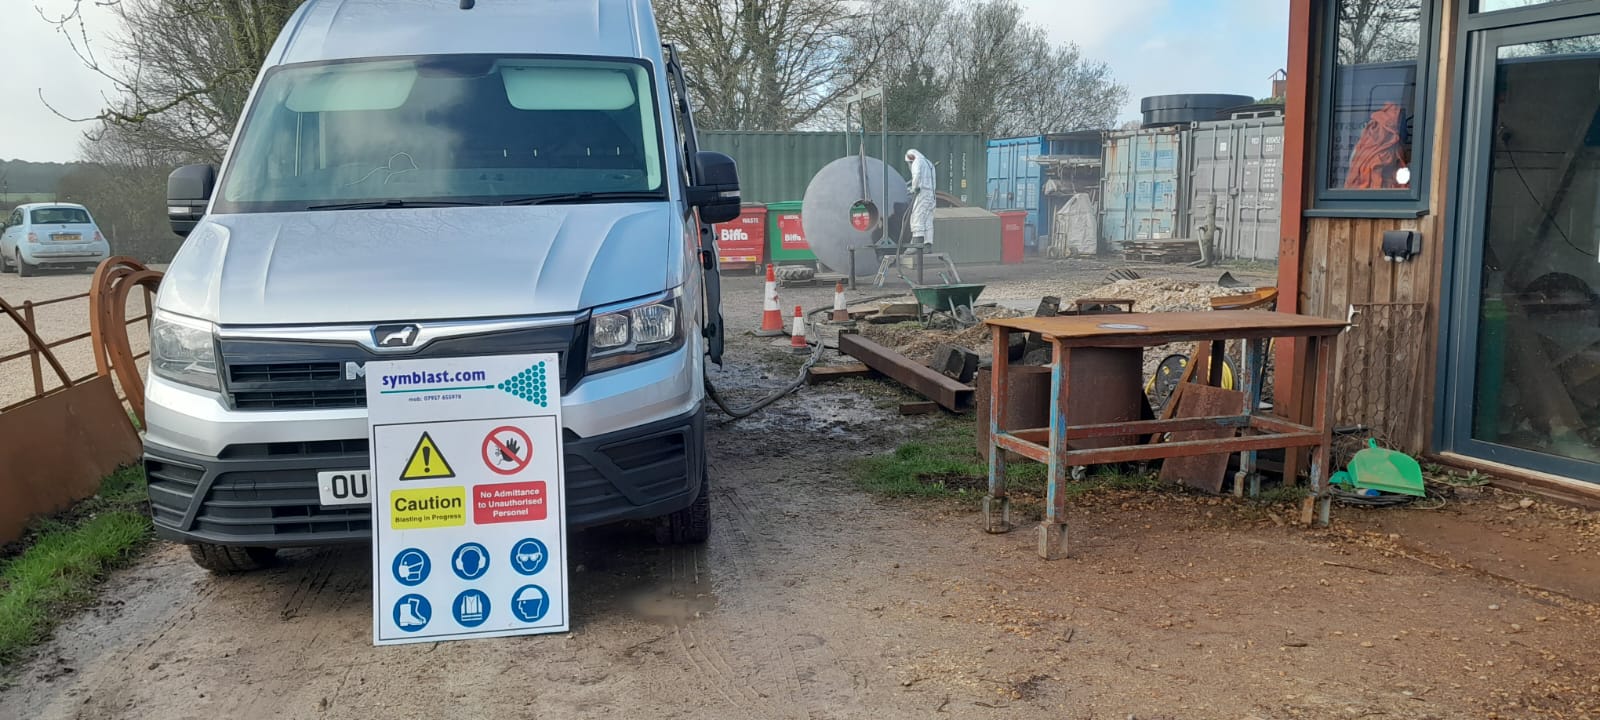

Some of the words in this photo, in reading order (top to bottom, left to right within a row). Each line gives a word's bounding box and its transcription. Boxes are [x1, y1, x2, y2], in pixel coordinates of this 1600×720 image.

[721, 228, 748, 241] Biffa
[784, 233, 802, 242] Biffa
[382, 370, 486, 389] symblast.com
[480, 491, 492, 499] No
[494, 488, 540, 498] Admittance
[395, 496, 462, 512] Caution
[478, 501, 487, 509] to
[488, 497, 543, 508] Unauthorised
[395, 515, 422, 523] Blasting
[432, 513, 462, 521] Progress
